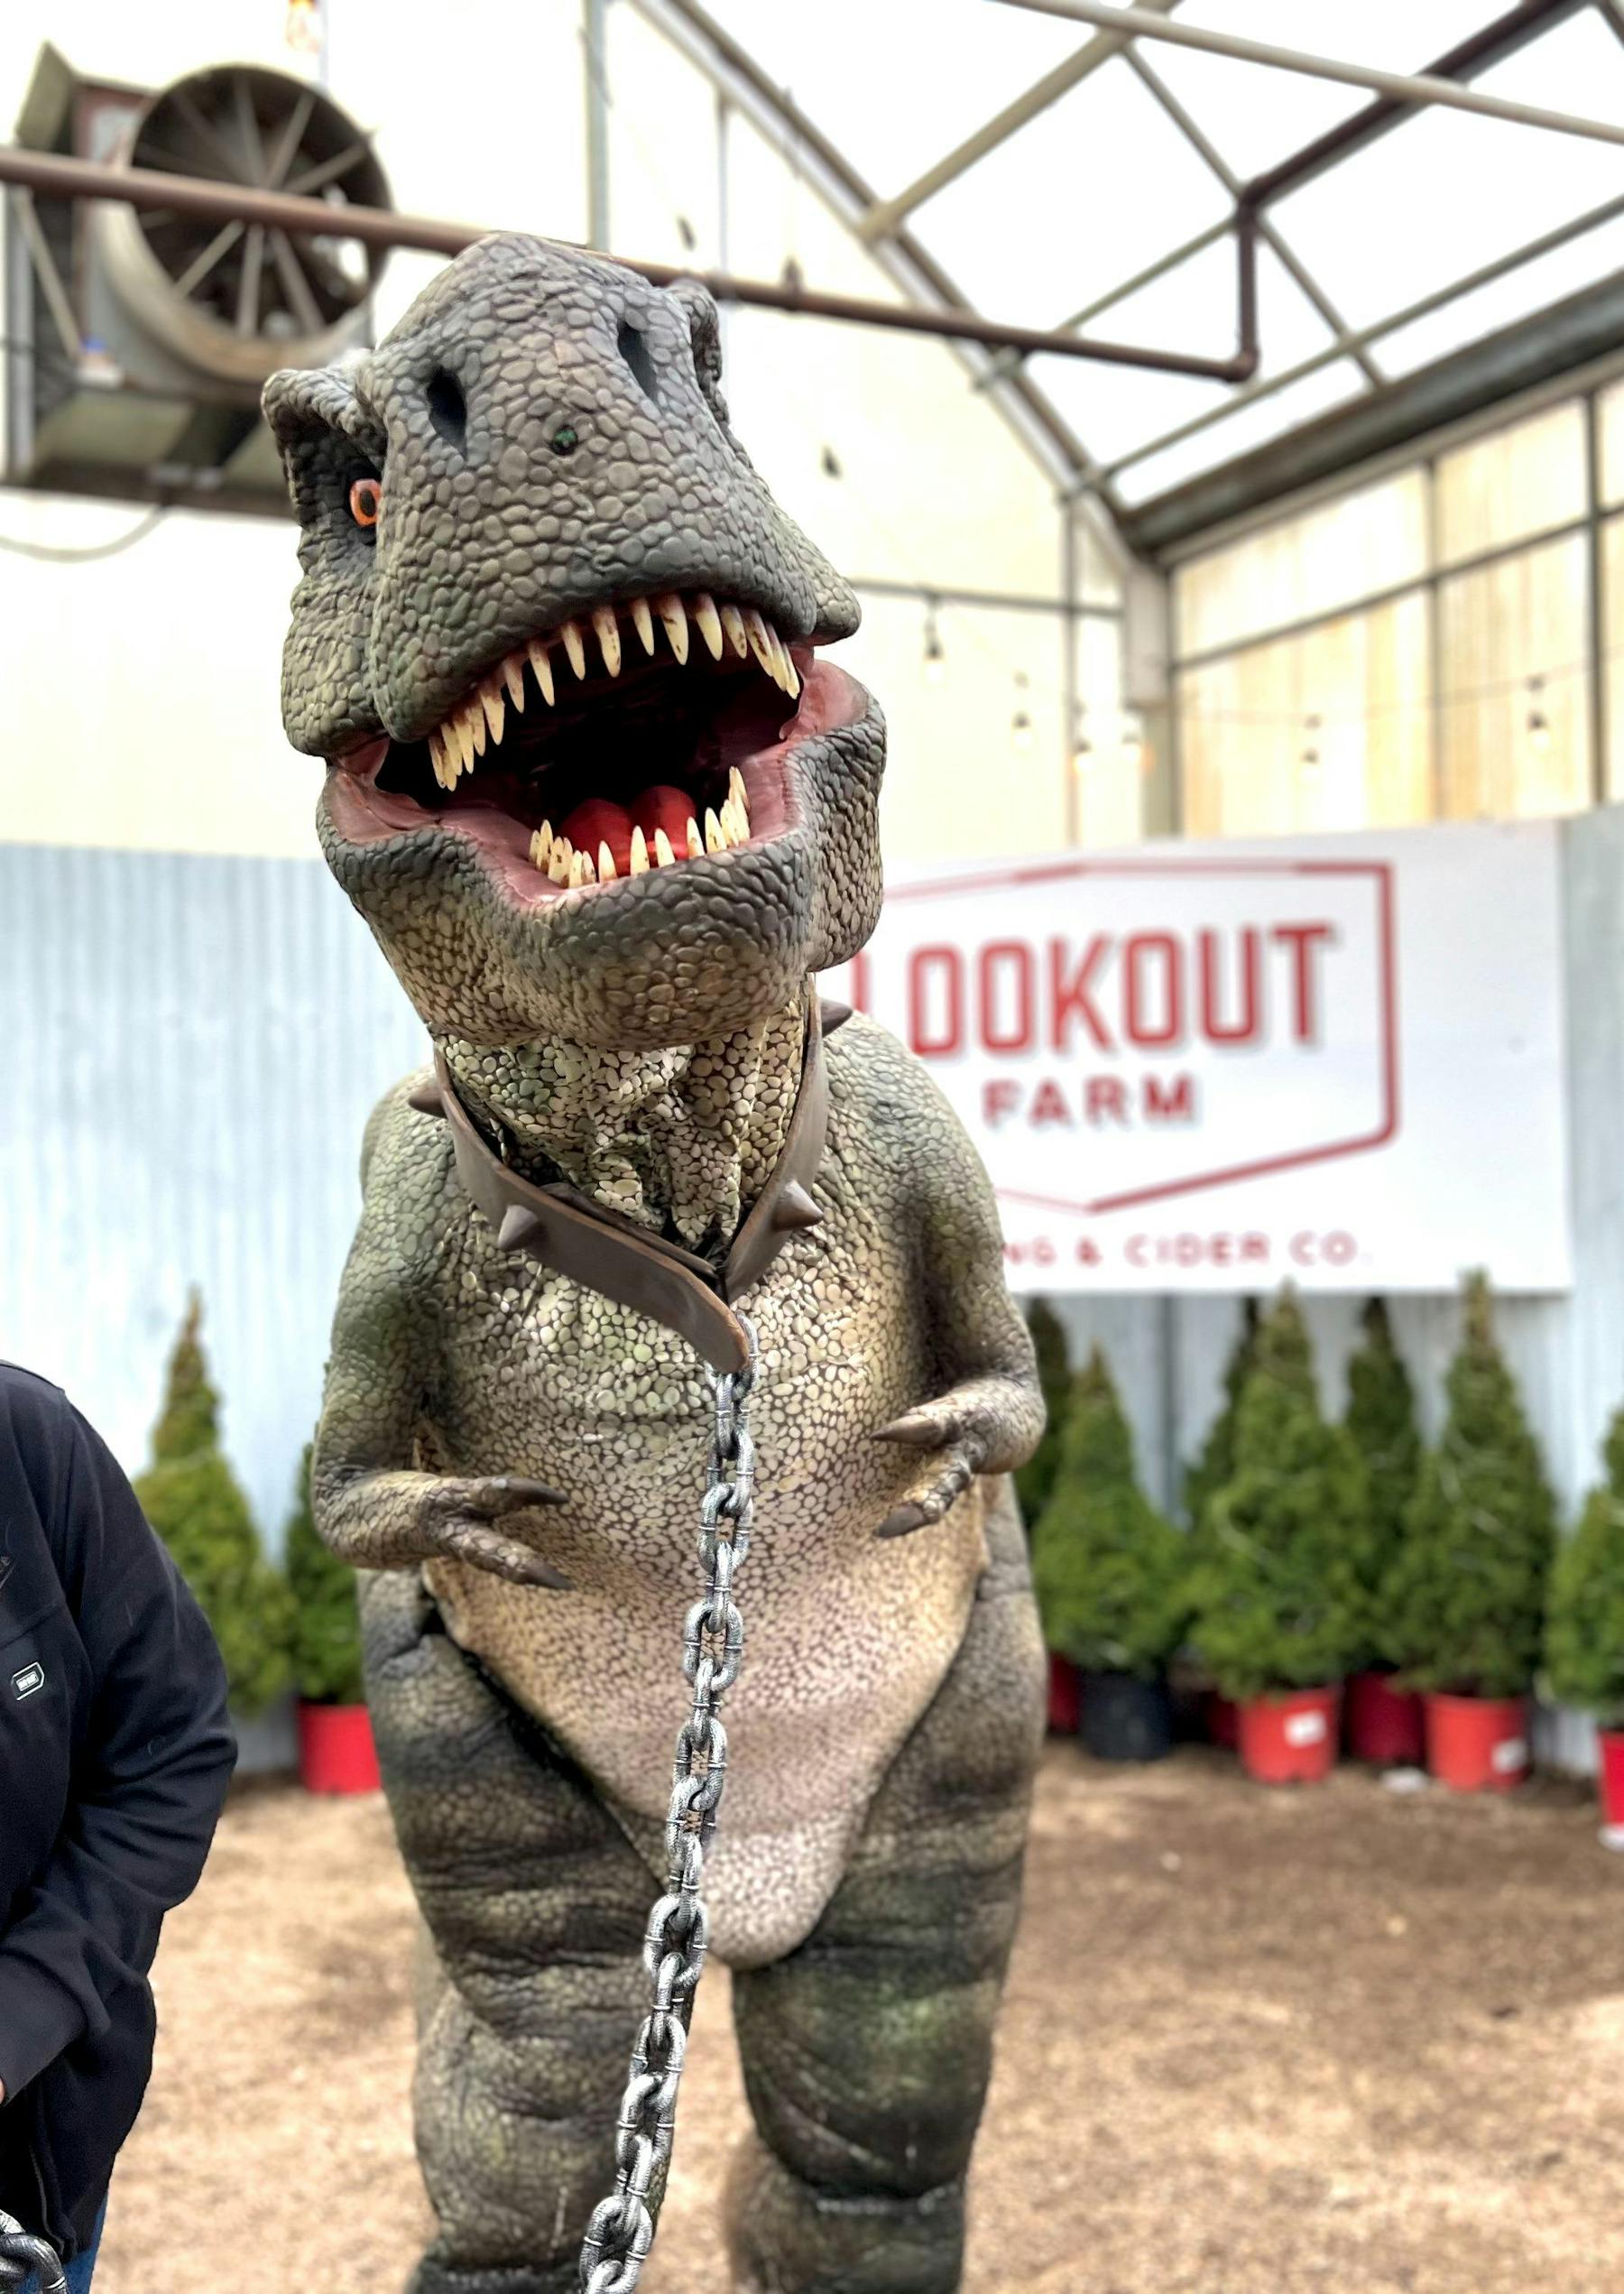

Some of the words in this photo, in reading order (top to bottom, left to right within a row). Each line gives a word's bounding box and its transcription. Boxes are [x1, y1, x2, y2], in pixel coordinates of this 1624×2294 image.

[982, 1074, 1195, 1126] FARM
[1075, 1236, 1103, 1266] &
[1124, 1234, 1269, 1266] CIDER
